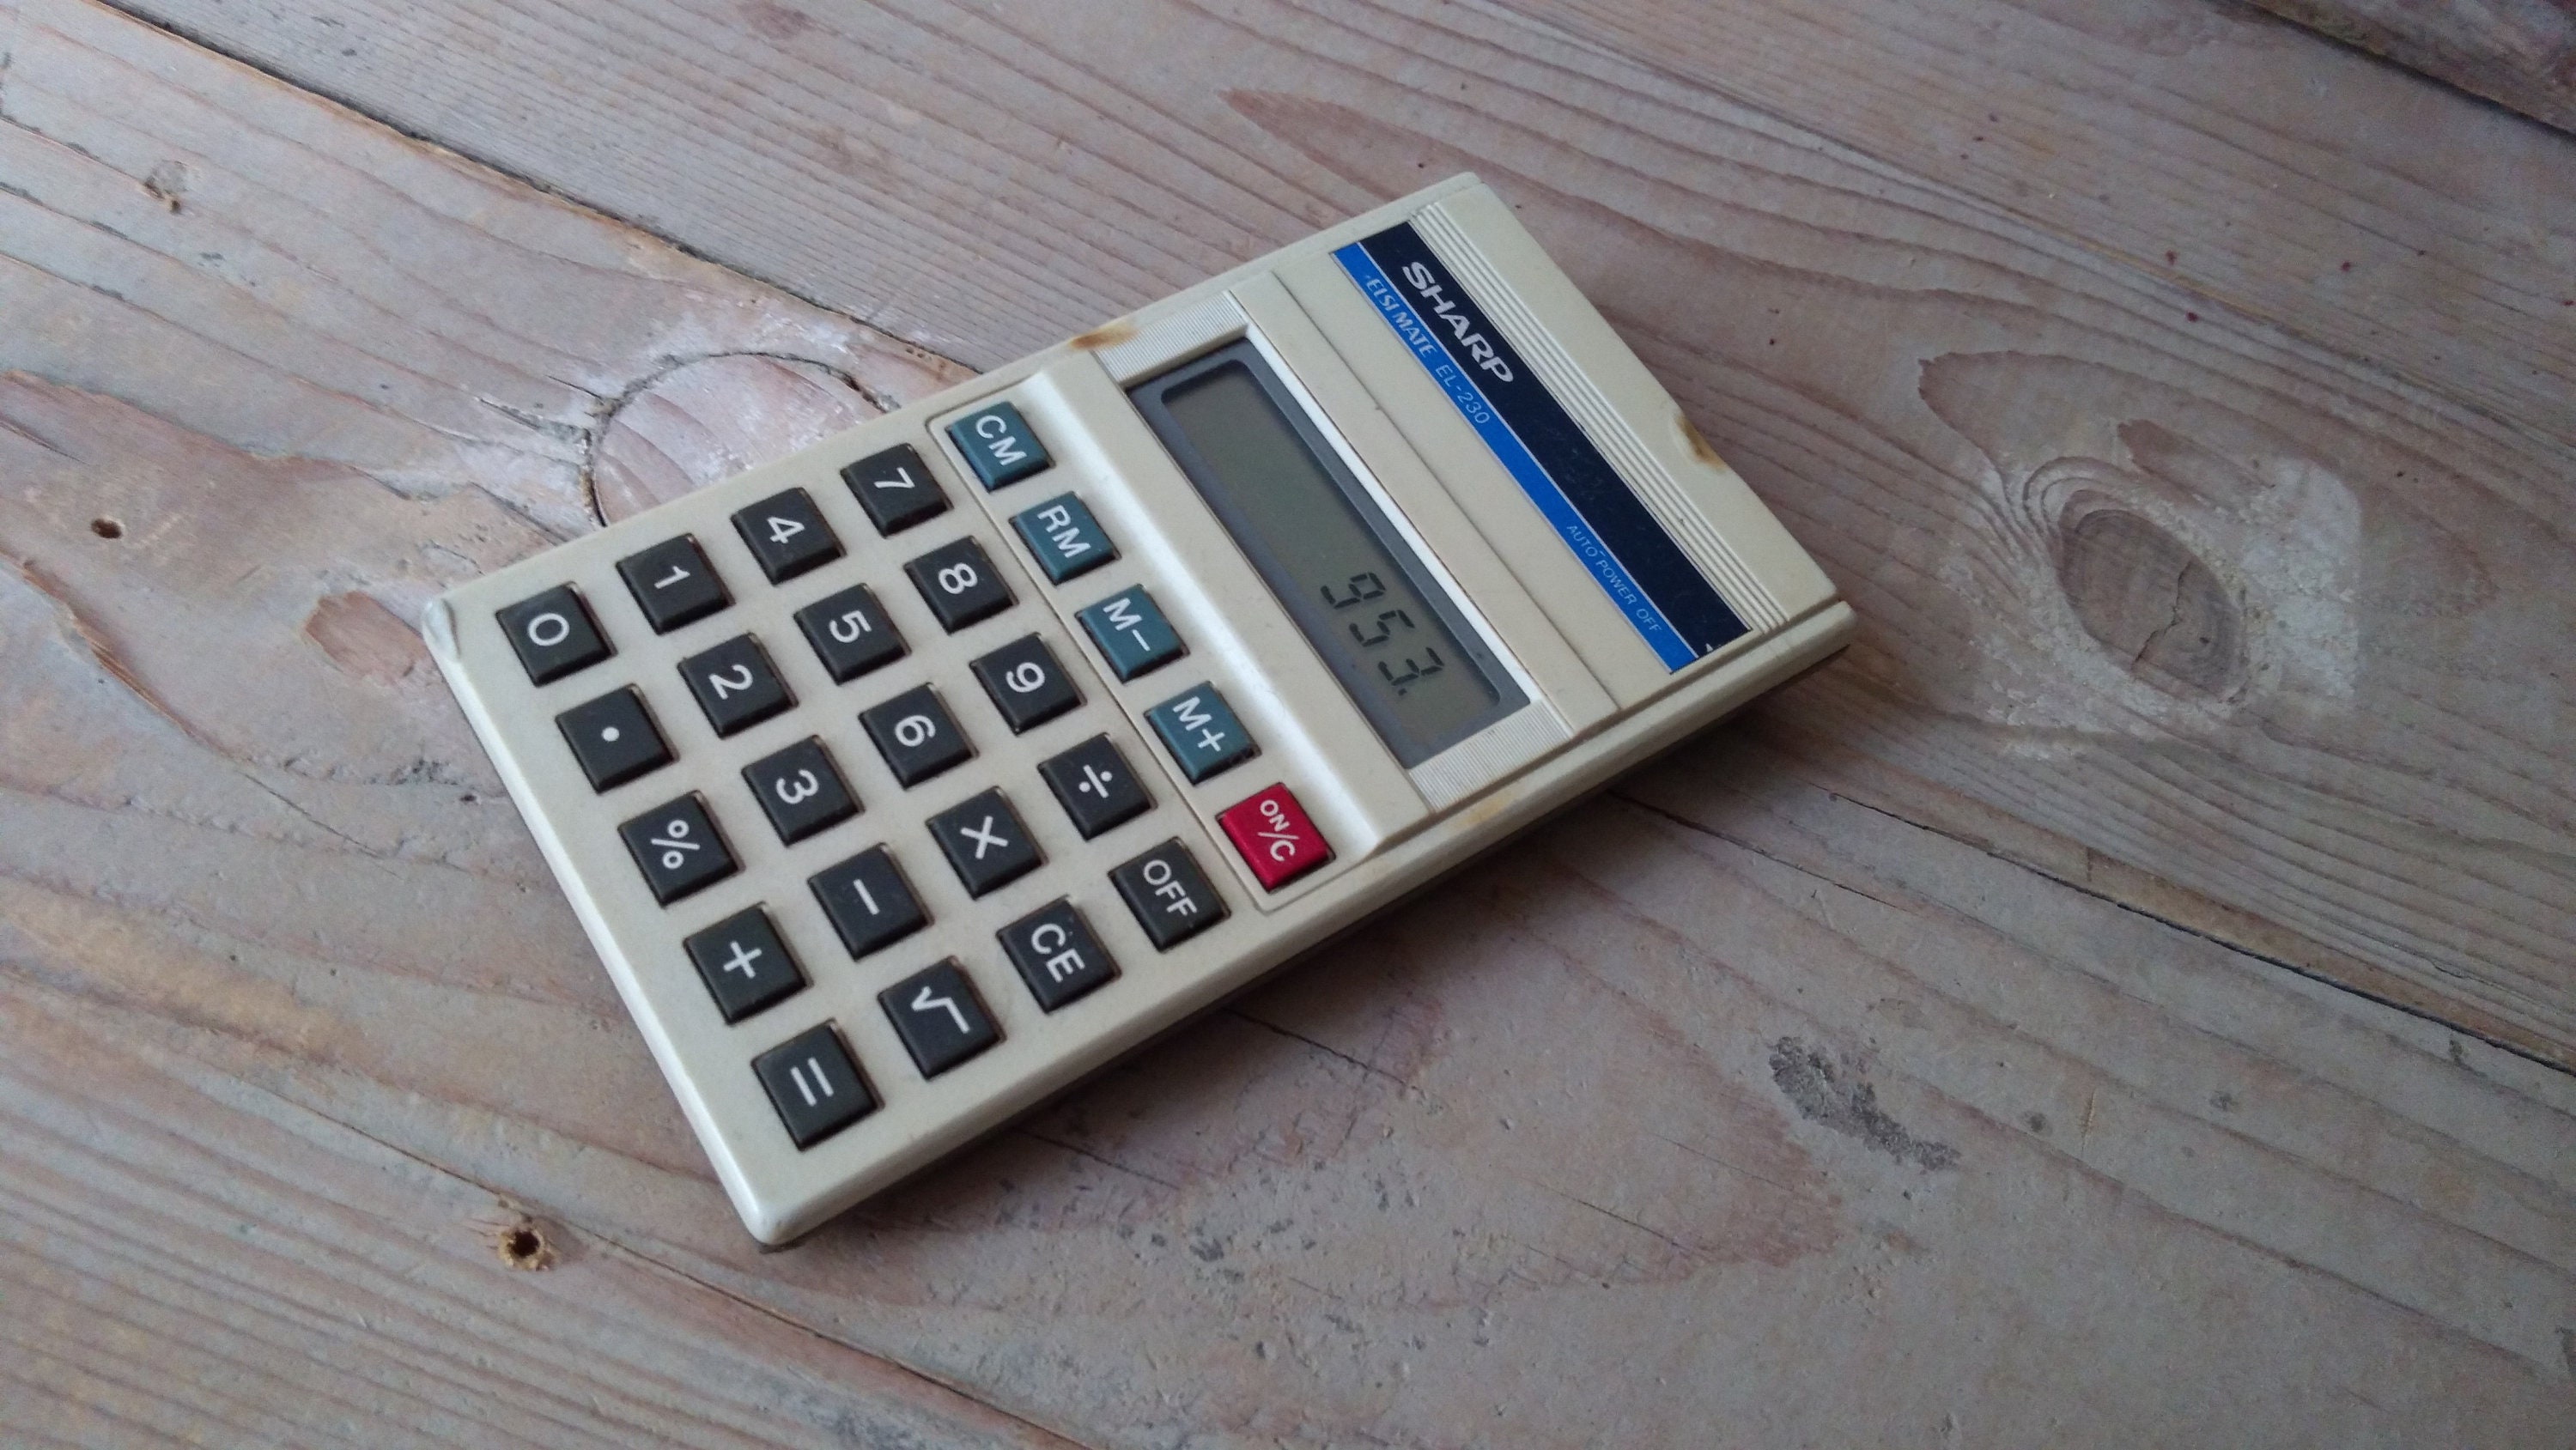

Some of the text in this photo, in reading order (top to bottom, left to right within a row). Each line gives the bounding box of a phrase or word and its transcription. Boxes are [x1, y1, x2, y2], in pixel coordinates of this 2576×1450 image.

[1402, 261, 1514, 382] SHARP
[1392, 312, 1437, 358] MATE
[1436, 364, 1491, 424] EL-230
[975, 415, 1027, 466] CM
[872, 466, 915, 489] 7
[767, 516, 805, 544] 4
[1037, 504, 1091, 559] RM
[654, 566, 690, 589] 1
[939, 563, 978, 594] 8
[1566, 525, 1662, 633] AUTO POWER OFF
[829, 610, 871, 643] 5
[1103, 597, 1151, 652] M-
[709, 664, 753, 700] 2
[1006, 662, 1045, 693] 9
[896, 714, 936, 747] 6
[1173, 696, 1225, 752] M+
[775, 769, 818, 804] 3
[1143, 859, 1197, 916] OFF
[1031, 923, 1086, 983] CE
